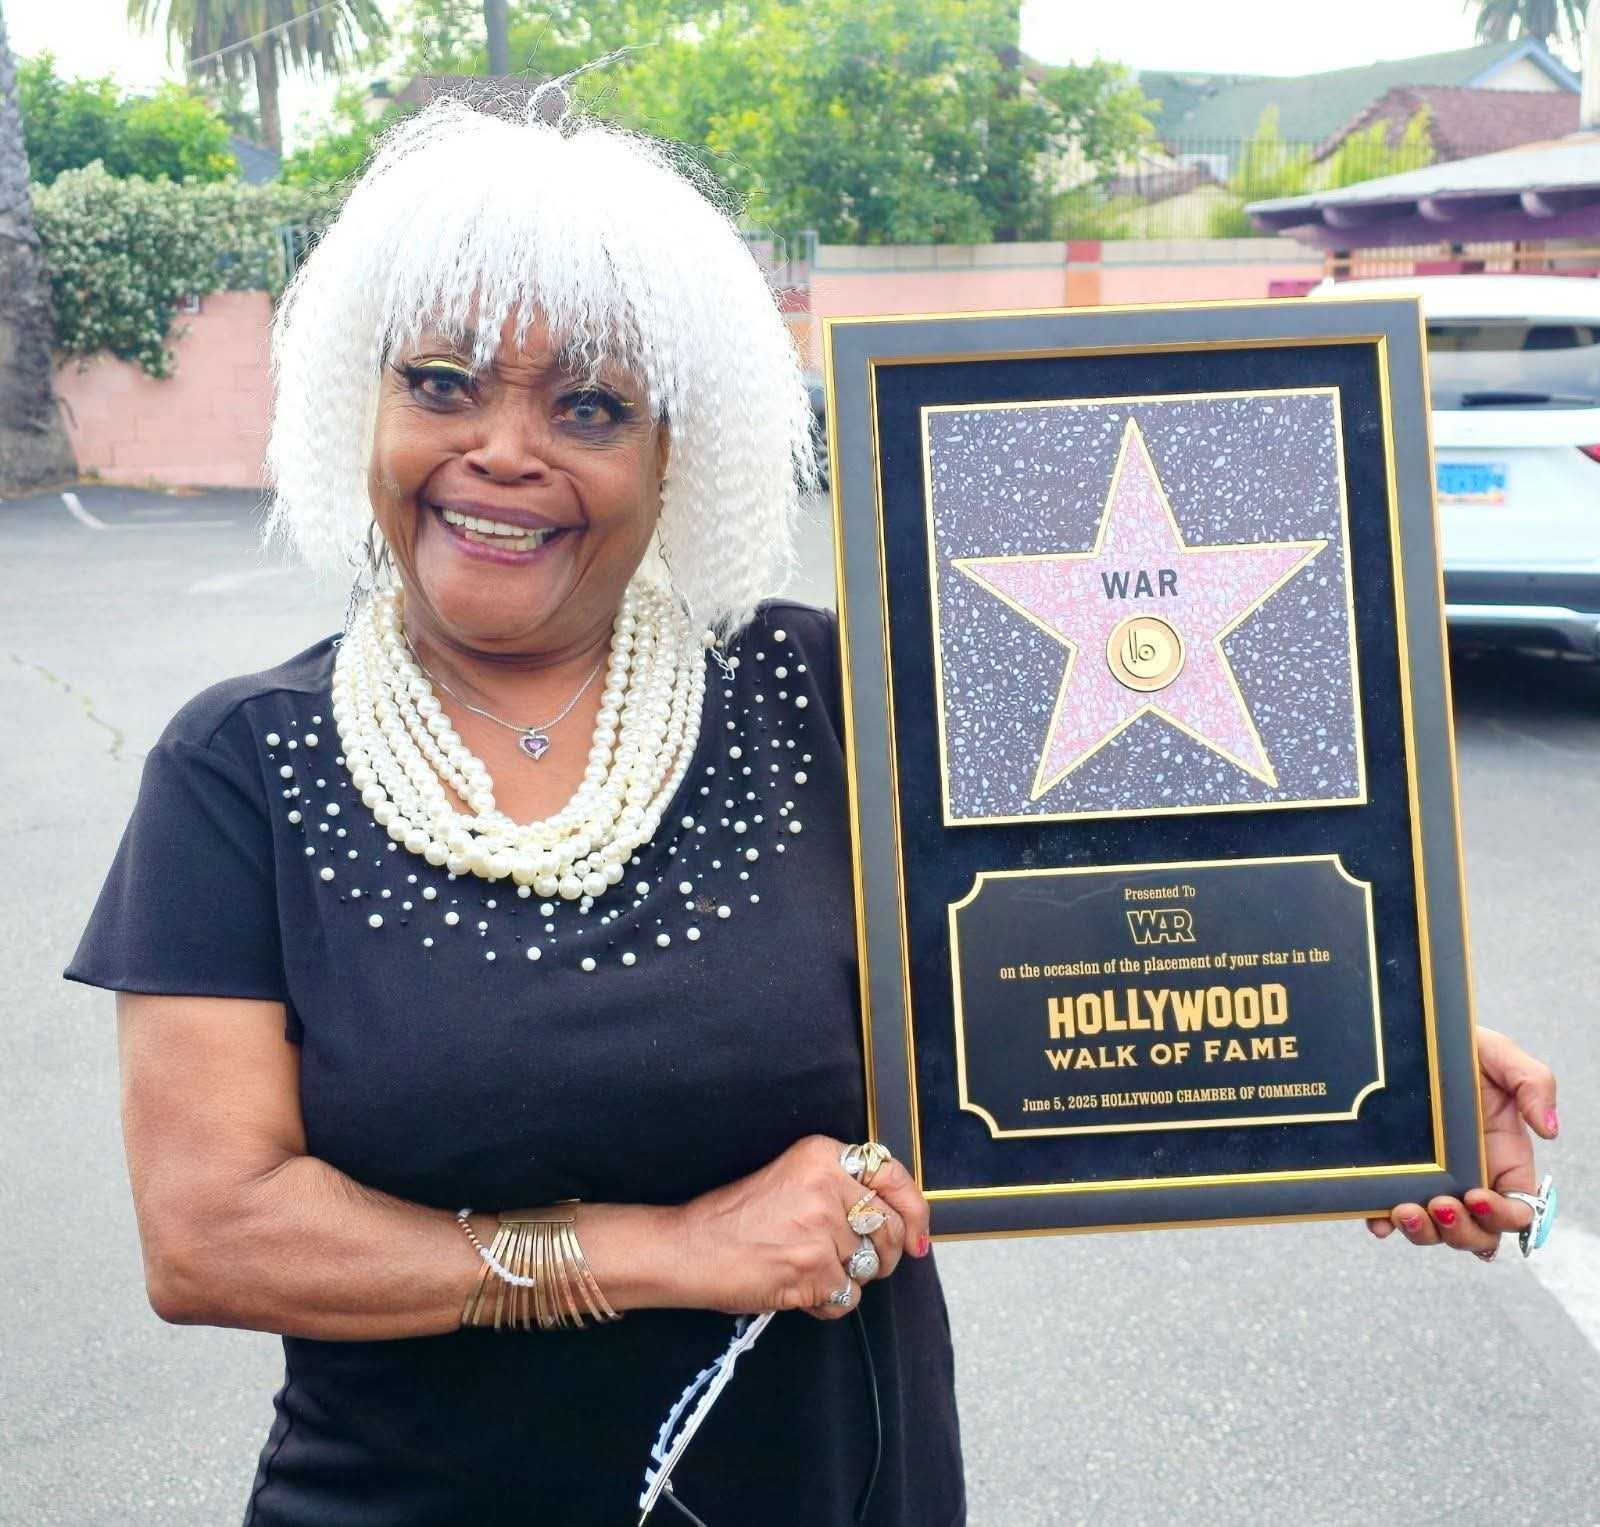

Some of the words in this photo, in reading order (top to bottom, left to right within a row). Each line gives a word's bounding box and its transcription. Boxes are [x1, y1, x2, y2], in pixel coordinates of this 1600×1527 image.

[1101, 569, 1178, 599] WAR
[1124, 886, 1179, 900] Presented
[1182, 885, 1196, 898] To
[1126, 908, 1196, 944] WAR
[1000, 967, 1016, 979] on
[1019, 963, 1040, 978] the
[1044, 961, 1100, 976] occasion
[1103, 958, 1117, 974] of
[1119, 957, 1140, 973] the
[1143, 954, 1211, 974] placement
[1214, 952, 1227, 968] of
[1229, 954, 1259, 970] your
[1262, 951, 1288, 965] star
[1292, 949, 1305, 963] in
[1309, 947, 1330, 962] the
[1048, 984, 1289, 1039] HOLLYWOOD
[1044, 1045, 1138, 1071] WALK
[1150, 1042, 1191, 1065] OF
[1204, 1036, 1299, 1063] FAME
[1022, 1098, 1050, 1112] June
[1053, 1096, 1065, 1111] 5,
[1068, 1095, 1097, 1109] 2025
[1101, 1090, 1173, 1108] HOLLYWOOD
[1176, 1087, 1237, 1103] CHAMBER
[1240, 1086, 1255, 1100] OF
[1258, 1082, 1327, 1098] COMMERCE
